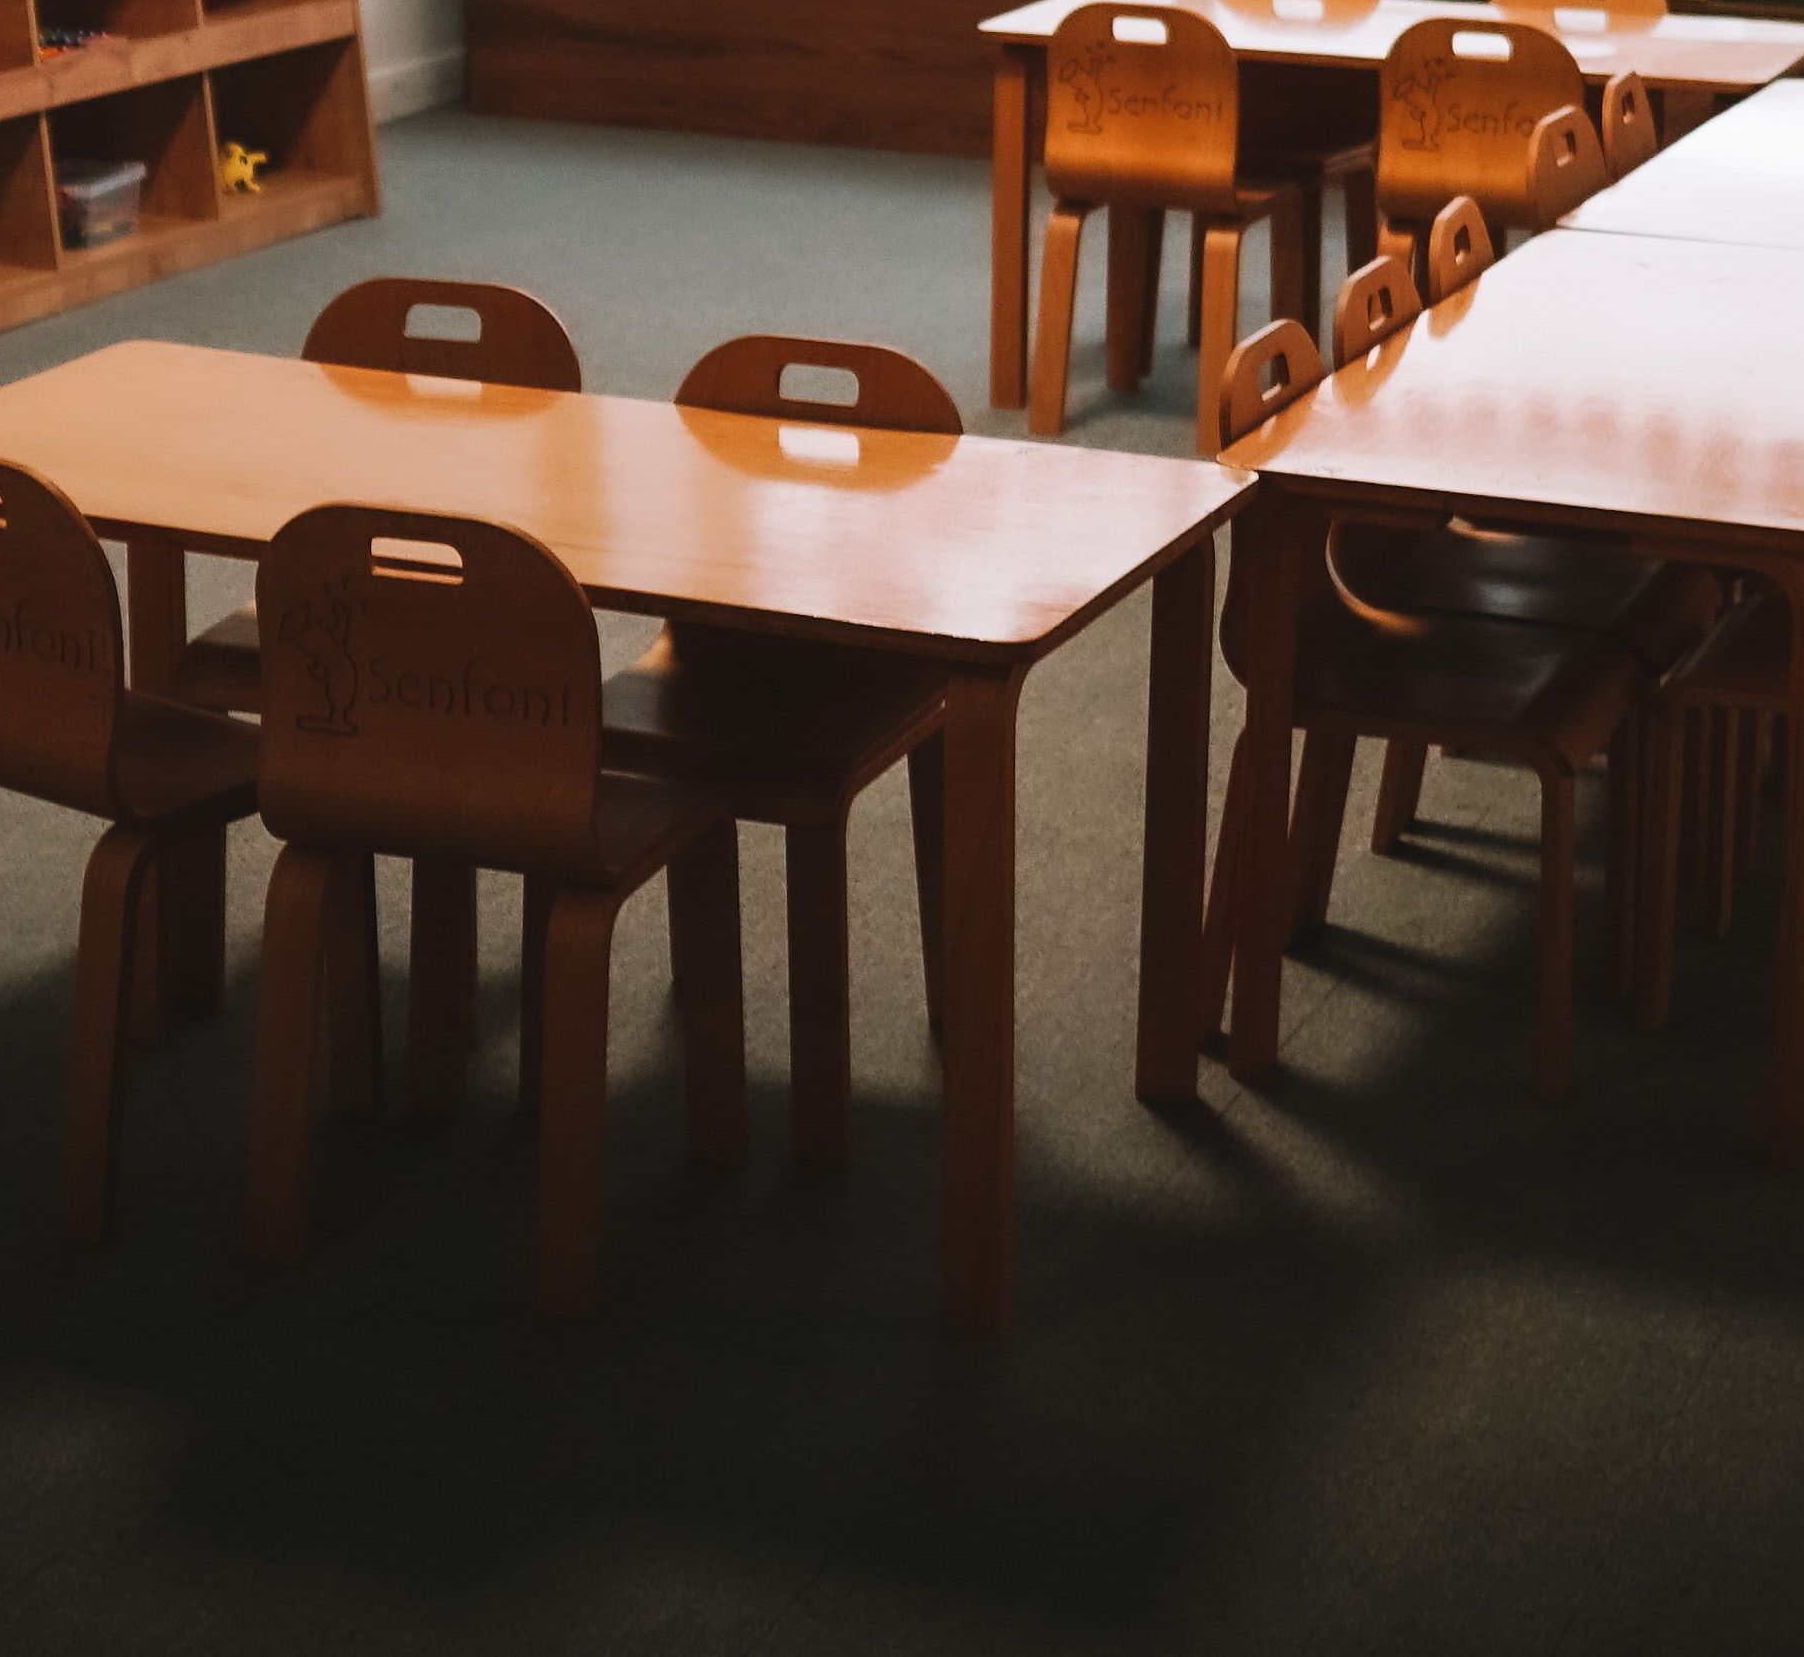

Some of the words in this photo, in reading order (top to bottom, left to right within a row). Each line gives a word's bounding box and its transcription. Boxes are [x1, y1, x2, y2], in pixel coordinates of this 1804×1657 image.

[1107, 82, 1224, 123] Senfoni
[1446, 101, 1535, 138] Senfo
[369, 656, 573, 727] Senfoni
